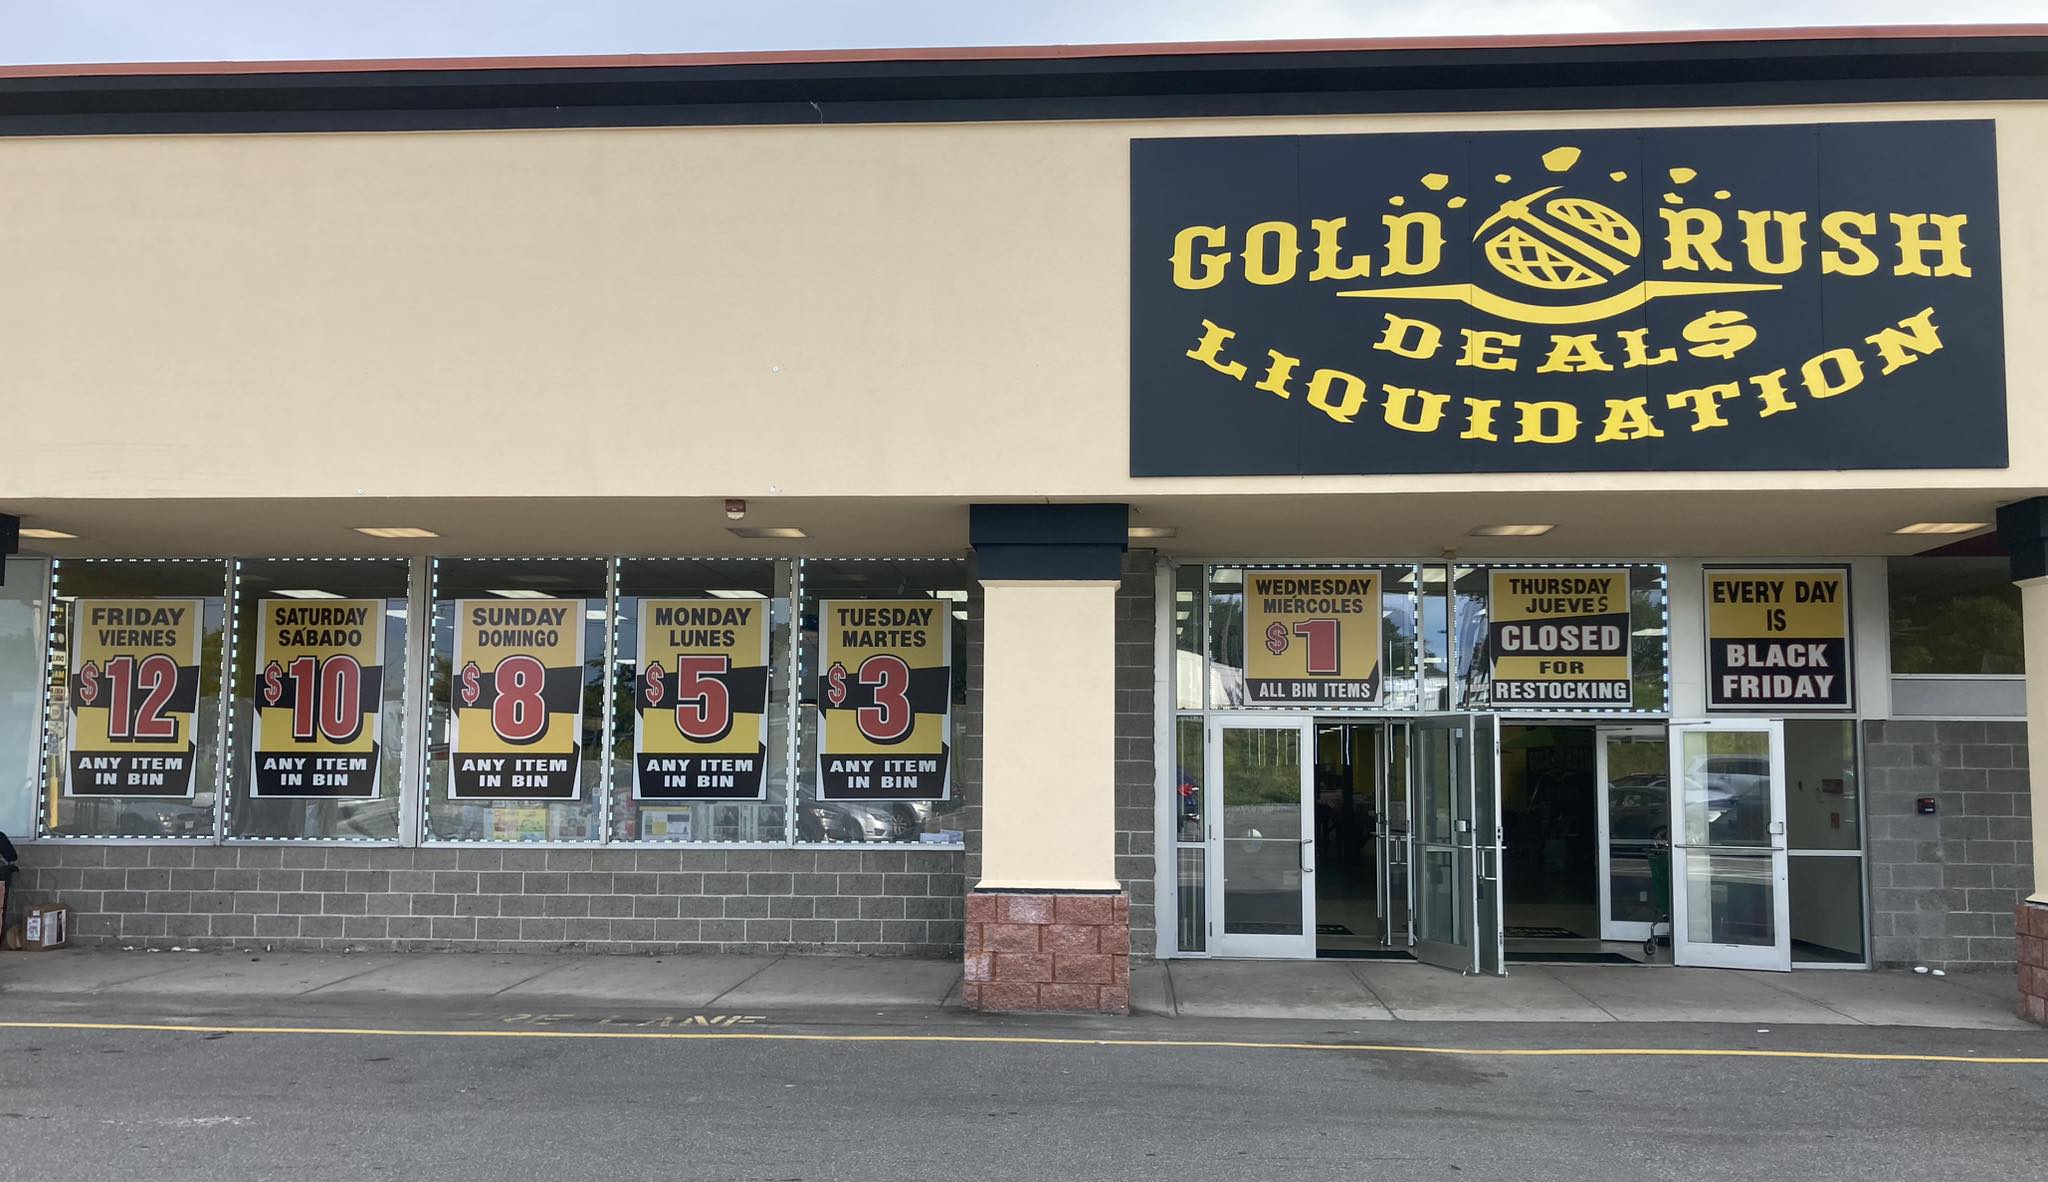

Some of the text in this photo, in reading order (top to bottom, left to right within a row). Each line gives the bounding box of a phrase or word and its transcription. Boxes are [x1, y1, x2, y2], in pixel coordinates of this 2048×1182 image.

[1168, 208, 1971, 289] GOLD RUSH
[1187, 308, 1942, 443] LIQUIDATION
[1256, 579, 1372, 595] WEDNESDAY
[1509, 578, 1612, 595] THURSDAY
[1712, 581, 1839, 603] EVERY DAY
[1264, 595, 1363, 614] MIÉRCOLES
[1525, 596, 1609, 613] JUEVES
[91, 607, 185, 626] FRIDAY
[275, 607, 368, 626] SATURDAY
[472, 607, 568, 626] SUNDAY
[655, 607, 752, 626] MONDAY
[837, 608, 934, 627] TUESDAY
[1767, 608, 1787, 632] IS
[99, 629, 177, 647] VIERNES
[279, 627, 362, 647] SÁBADO
[478, 630, 559, 647] DOMINGO
[669, 629, 735, 647] LUNES
[842, 630, 927, 648] MARTES
[1266, 618, 1339, 673] $1
[1501, 625, 1620, 651] CLOSED
[1726, 644, 1829, 667] BLACK
[1539, 661, 1584, 675] FOR
[1259, 682, 1371, 698] ALL BIN ITEMS
[1495, 682, 1627, 699] RESTOCKING
[1722, 675, 1835, 698] FRIDAY
[78, 757, 183, 770] ANY ITEM
[263, 758, 367, 771] ANY ITEM
[461, 759, 567, 772] ANY ITEM
[646, 759, 753, 772] ANY ITEM
[830, 760, 937, 773] ANY ITEM
[95, 772, 164, 786] IN BIN
[280, 773, 349, 786] IN BIN
[479, 774, 548, 787] IN BIN
[664, 775, 734, 788] IN BIN
[847, 776, 918, 788] IN BIN
